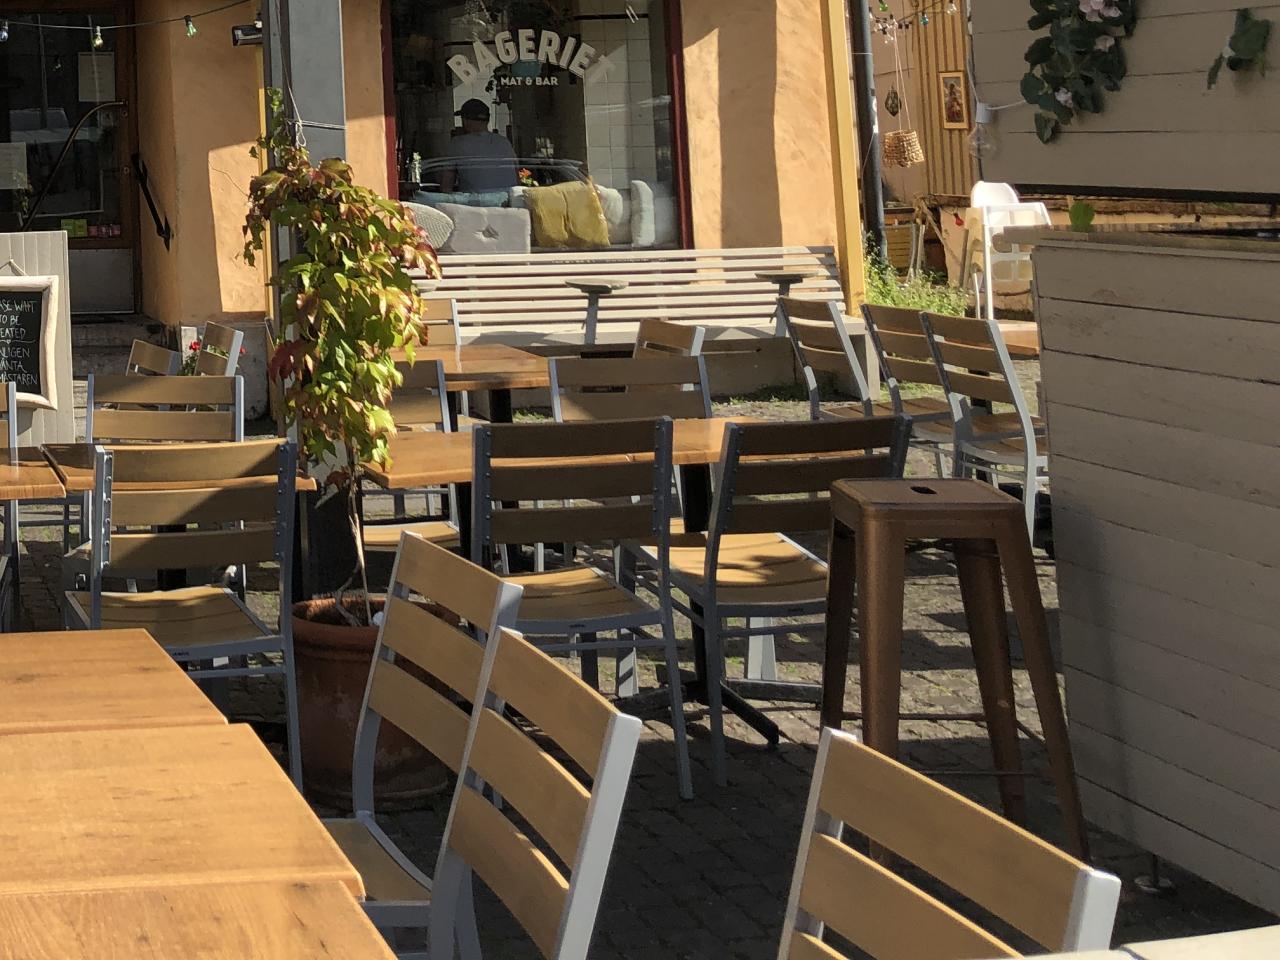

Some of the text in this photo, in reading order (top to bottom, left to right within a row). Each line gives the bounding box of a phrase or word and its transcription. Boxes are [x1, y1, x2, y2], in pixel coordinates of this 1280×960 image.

[446, 28, 616, 84] BAGERIET
[500, 76, 559, 86] MAT & BAR
[9, 314, 21, 327] BE
